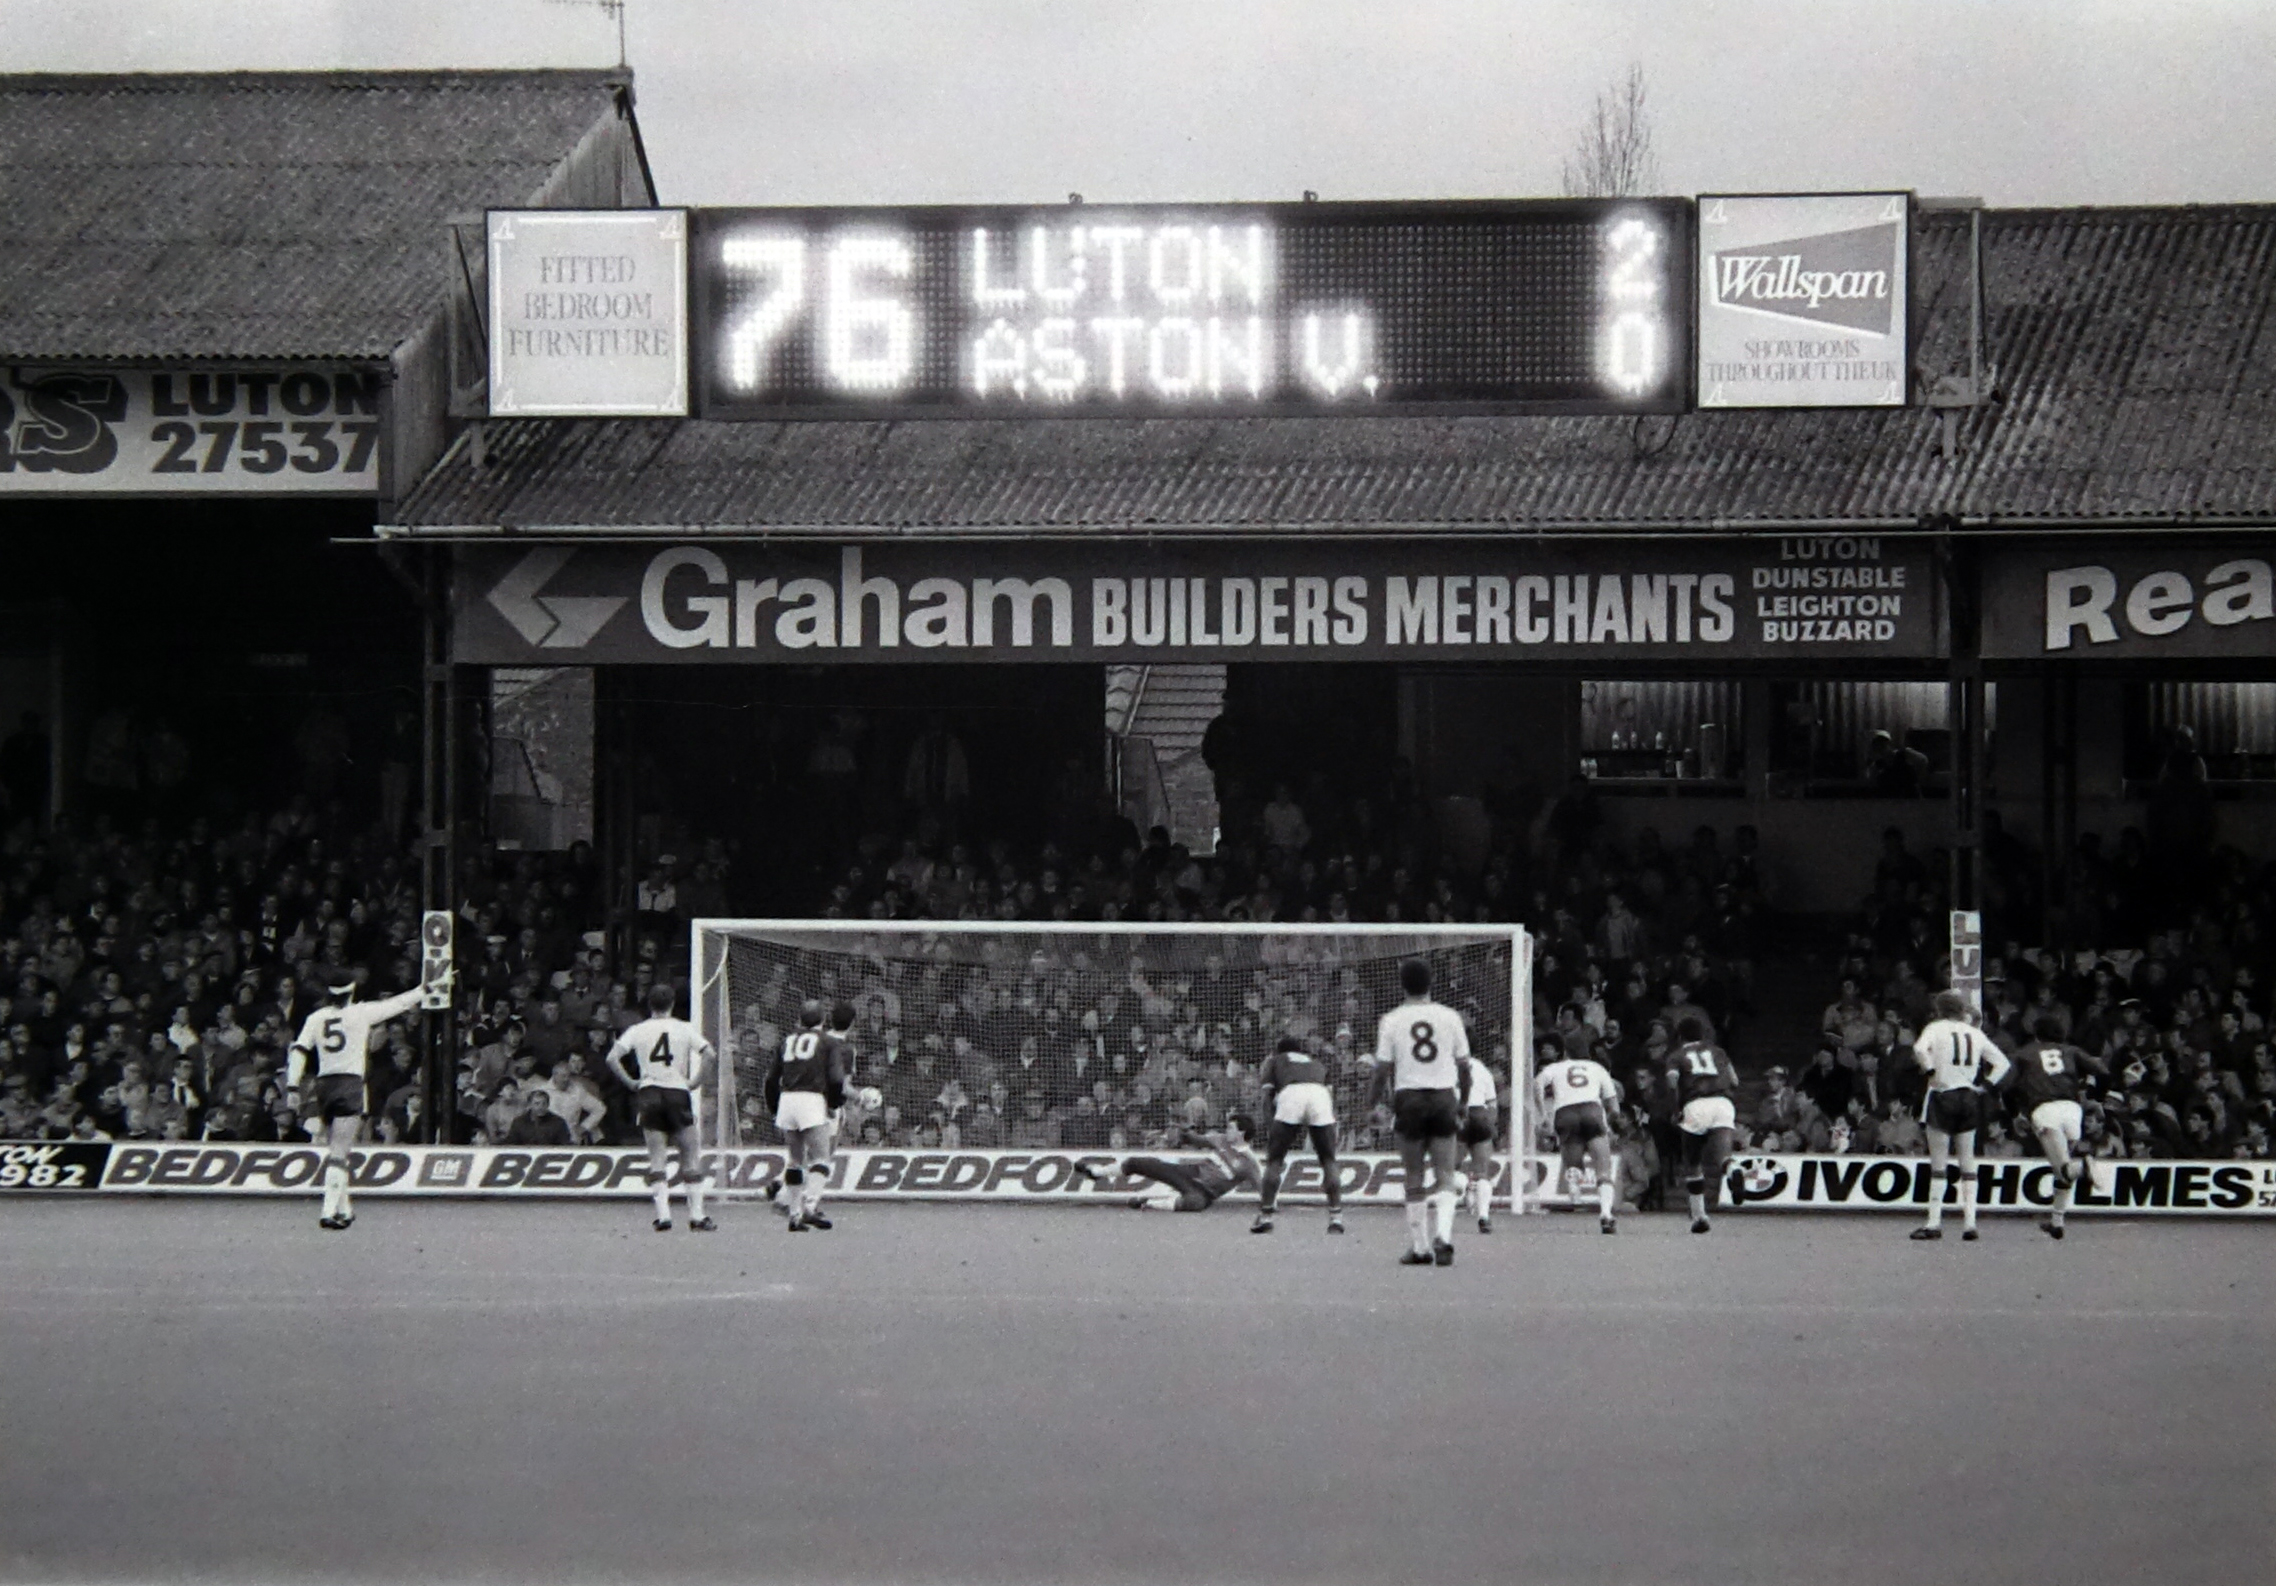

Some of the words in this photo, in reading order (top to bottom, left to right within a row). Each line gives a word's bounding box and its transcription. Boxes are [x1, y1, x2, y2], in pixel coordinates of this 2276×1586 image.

[541, 256, 636, 283] FITTED
[973, 226, 1264, 300] LUTON
[1609, 220, 1656, 296] 2
[1721, 254, 1888, 308] Wallspan
[525, 292, 653, 320] BEDROOM
[721, 236, 911, 391] 76
[509, 328, 670, 357] FURNITURE
[973, 317, 1264, 396] ASTON
[1304, 311, 1379, 396] V.
[1608, 312, 1654, 393] 0
[1745, 339, 1861, 359] SHOWROOMS
[152, 373, 380, 416] LUTON
[0, 372, 129, 474] S
[152, 421, 379, 474] 27537
[1781, 538, 1881, 561] LUTON
[1752, 566, 1906, 589] DUNSTABLE
[640, 546, 1073, 650] Graham
[1091, 576, 1368, 646] BUILDERS
[1385, 573, 1735, 646] MERCHANTS
[1757, 595, 1900, 618] LEIGHTON
[2046, 558, 2276, 652] Rea
[1762, 620, 1896, 643] BUZZARD
[323, 1018, 348, 1055] 5
[648, 1032, 673, 1066] 4
[783, 1032, 819, 1062] 10
[1410, 1022, 1438, 1063] 8
[1951, 1032, 1972, 1067] 11
[1567, 1065, 1589, 1088] 6
[1686, 1051, 1718, 1075] 11
[104, 1148, 411, 1188] BEDFORD
[432, 1159, 462, 1180] GM
[1235, 1158, 1548, 1197] EDFD
[1797, 1160, 1963, 1204] IVOR
[1977, 1164, 2254, 1208] HOLMES
